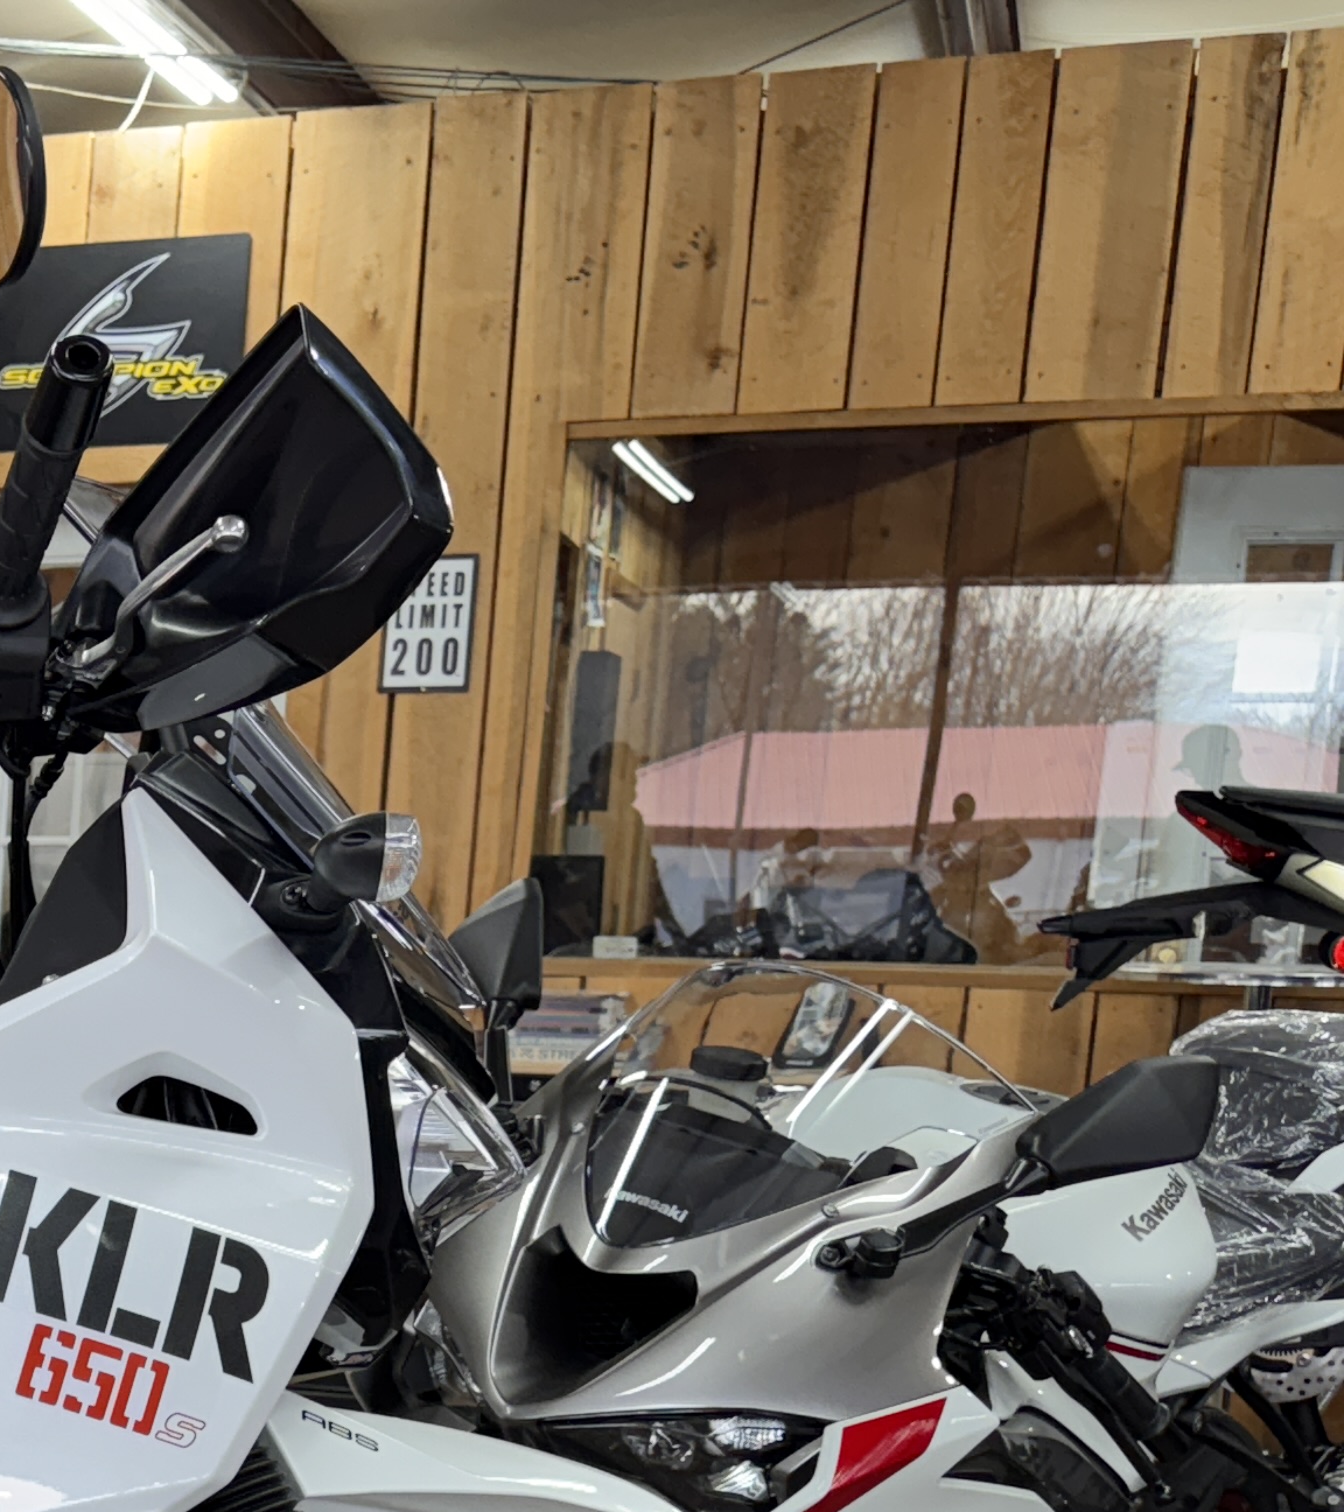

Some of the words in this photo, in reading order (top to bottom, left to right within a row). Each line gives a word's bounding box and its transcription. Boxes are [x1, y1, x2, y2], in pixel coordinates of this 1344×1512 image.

[1, 360, 197, 386] SCPION
[153, 374, 225, 395] EXO
[412, 571, 466, 597] EED
[395, 603, 464, 629] LIMIT
[390, 637, 459, 676] 200
[1120, 1167, 1188, 1242] Kawasaki
[300, 1409, 380, 1453] ABS
